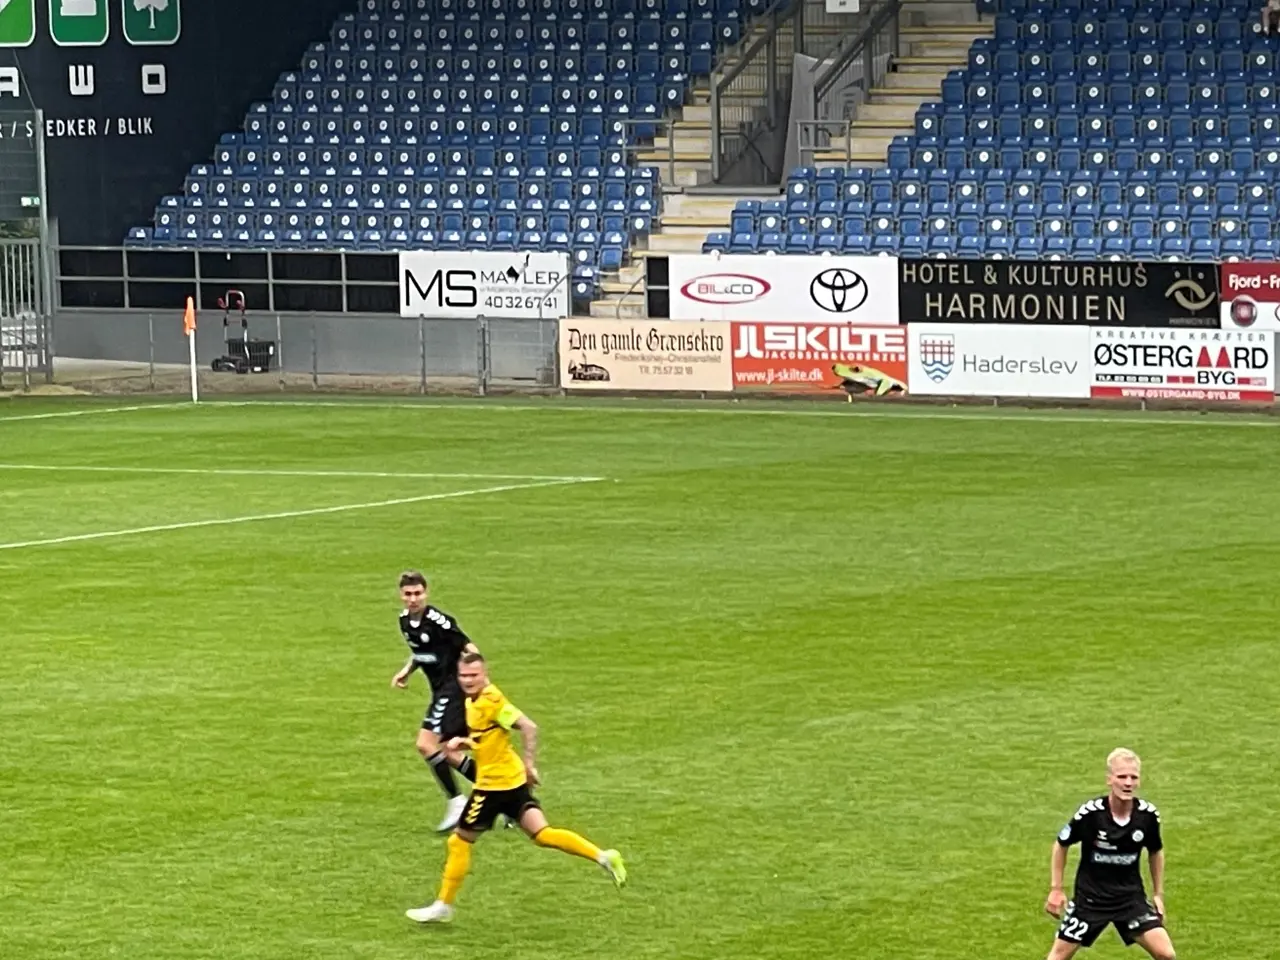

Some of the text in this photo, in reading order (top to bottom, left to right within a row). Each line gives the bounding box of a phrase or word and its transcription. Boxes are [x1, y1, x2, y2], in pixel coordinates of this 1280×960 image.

[69, 65, 94, 95] W
[142, 64, 166, 94] O
[26, 118, 97, 137] SEDKER
[118, 117, 152, 135] BLIK
[903, 264, 1148, 287] HOTEL & KULTURHUS
[405, 269, 477, 307] MS
[925, 293, 1126, 321] HARMONIEN
[568, 328, 596, 351] Den
[601, 328, 641, 354] gamle
[1096, 330, 1266, 342] KREATIVE KRÆFTER
[962, 354, 1078, 375] Haderslev
[1094, 343, 1268, 369] ØSTERGAARD
[1197, 371, 1236, 385] BYG
[1063, 917, 1089, 941] 22
